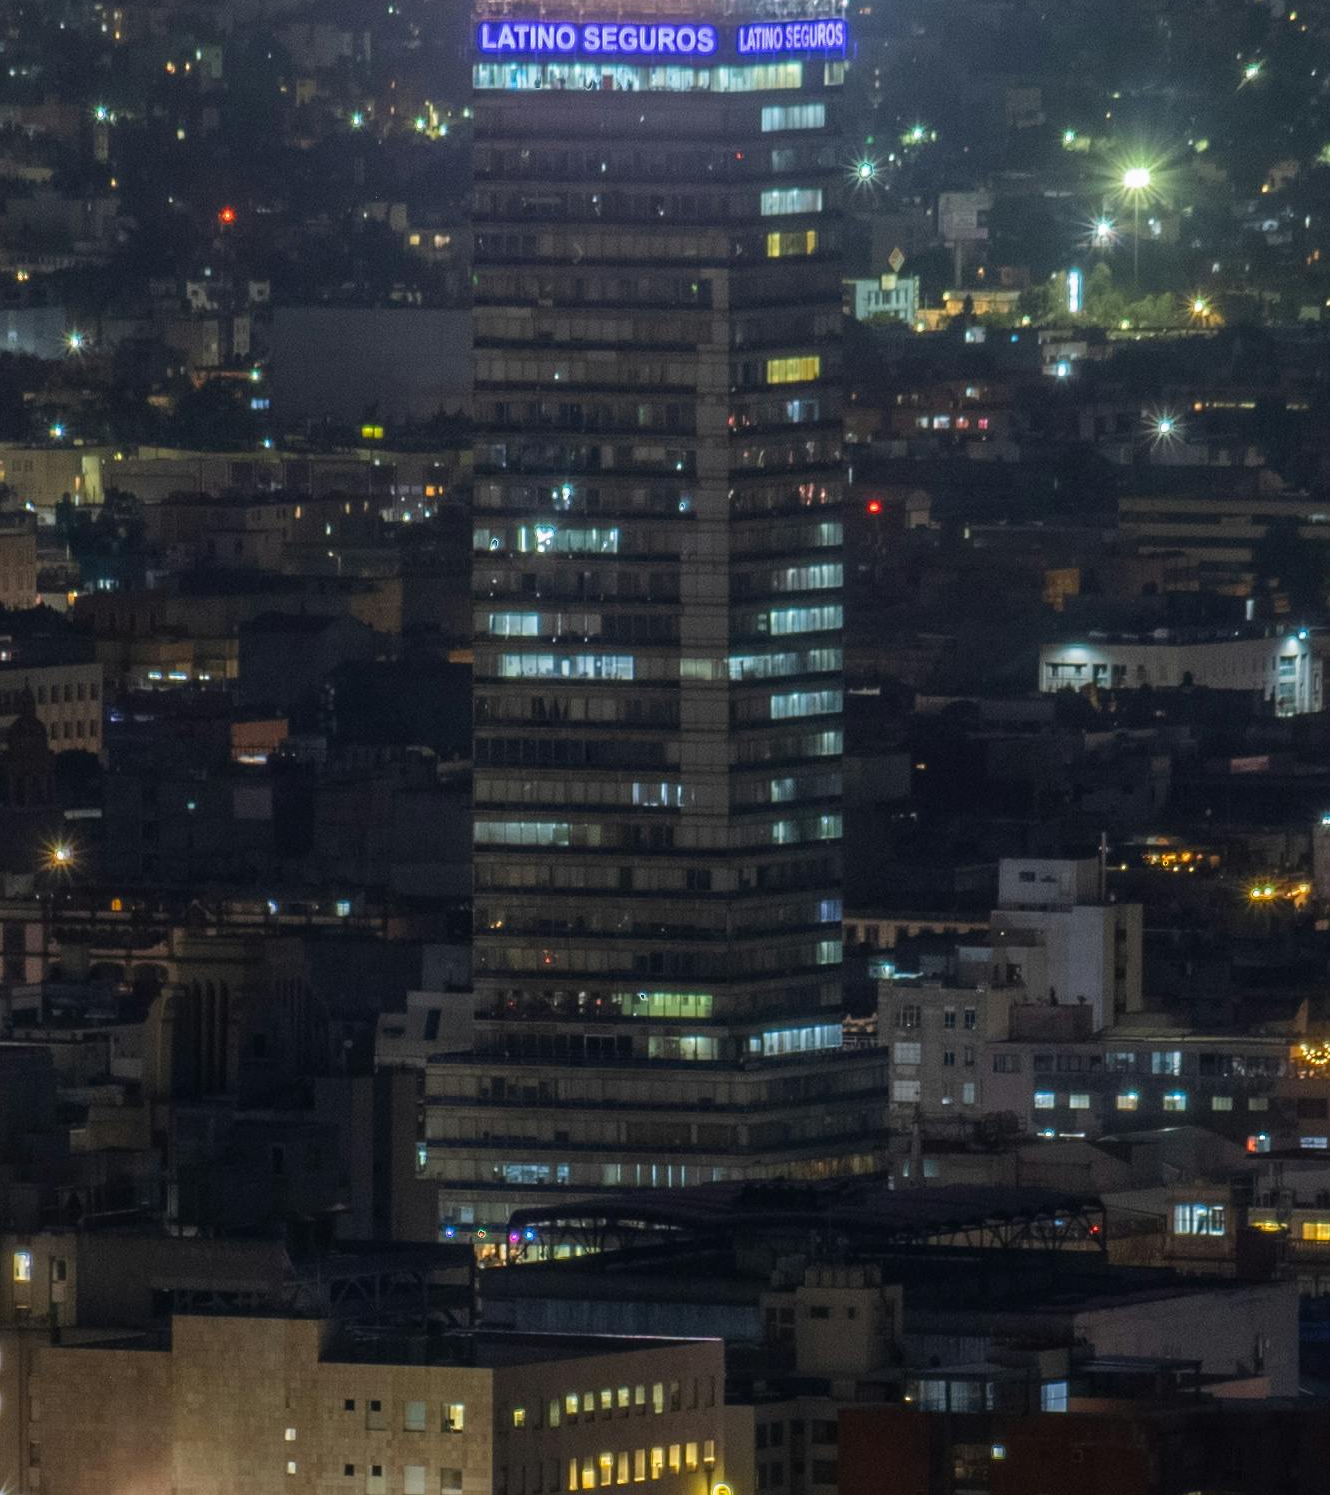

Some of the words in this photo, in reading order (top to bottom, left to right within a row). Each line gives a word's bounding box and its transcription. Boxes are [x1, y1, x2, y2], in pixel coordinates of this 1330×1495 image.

[481, 22, 576, 51] LATINO
[583, 25, 715, 53] SEGUROS
[738, 24, 783, 52] LATINO
[784, 21, 844, 50] SEGUROS
